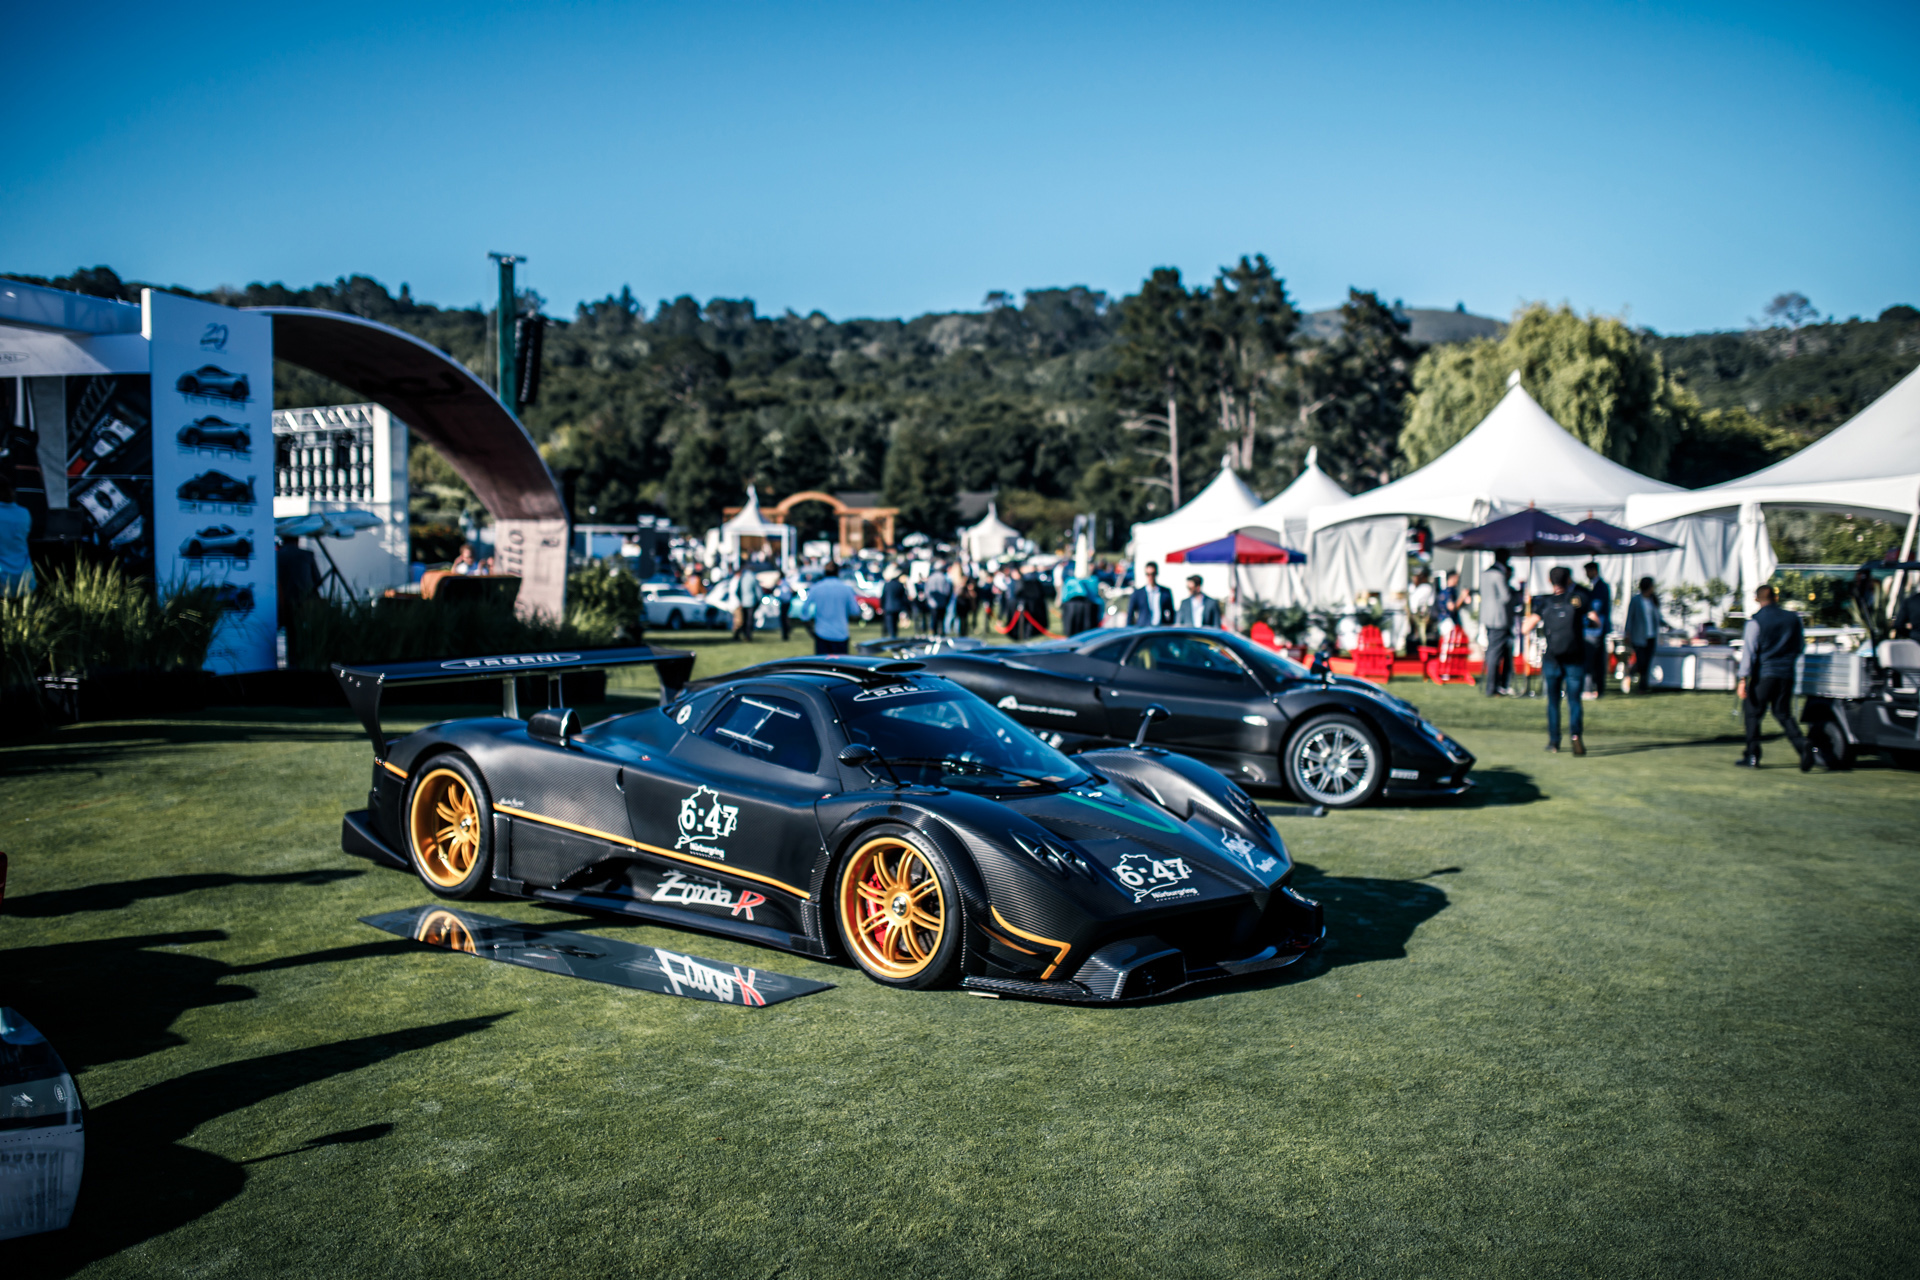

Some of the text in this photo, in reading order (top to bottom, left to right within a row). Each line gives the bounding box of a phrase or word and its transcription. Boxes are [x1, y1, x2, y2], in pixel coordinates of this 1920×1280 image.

[464, 653, 561, 668] PAGANI
[681, 798, 739, 837] 6:47
[1114, 857, 1191, 886] 6:47
[651, 869, 767, 921] Zonda R
